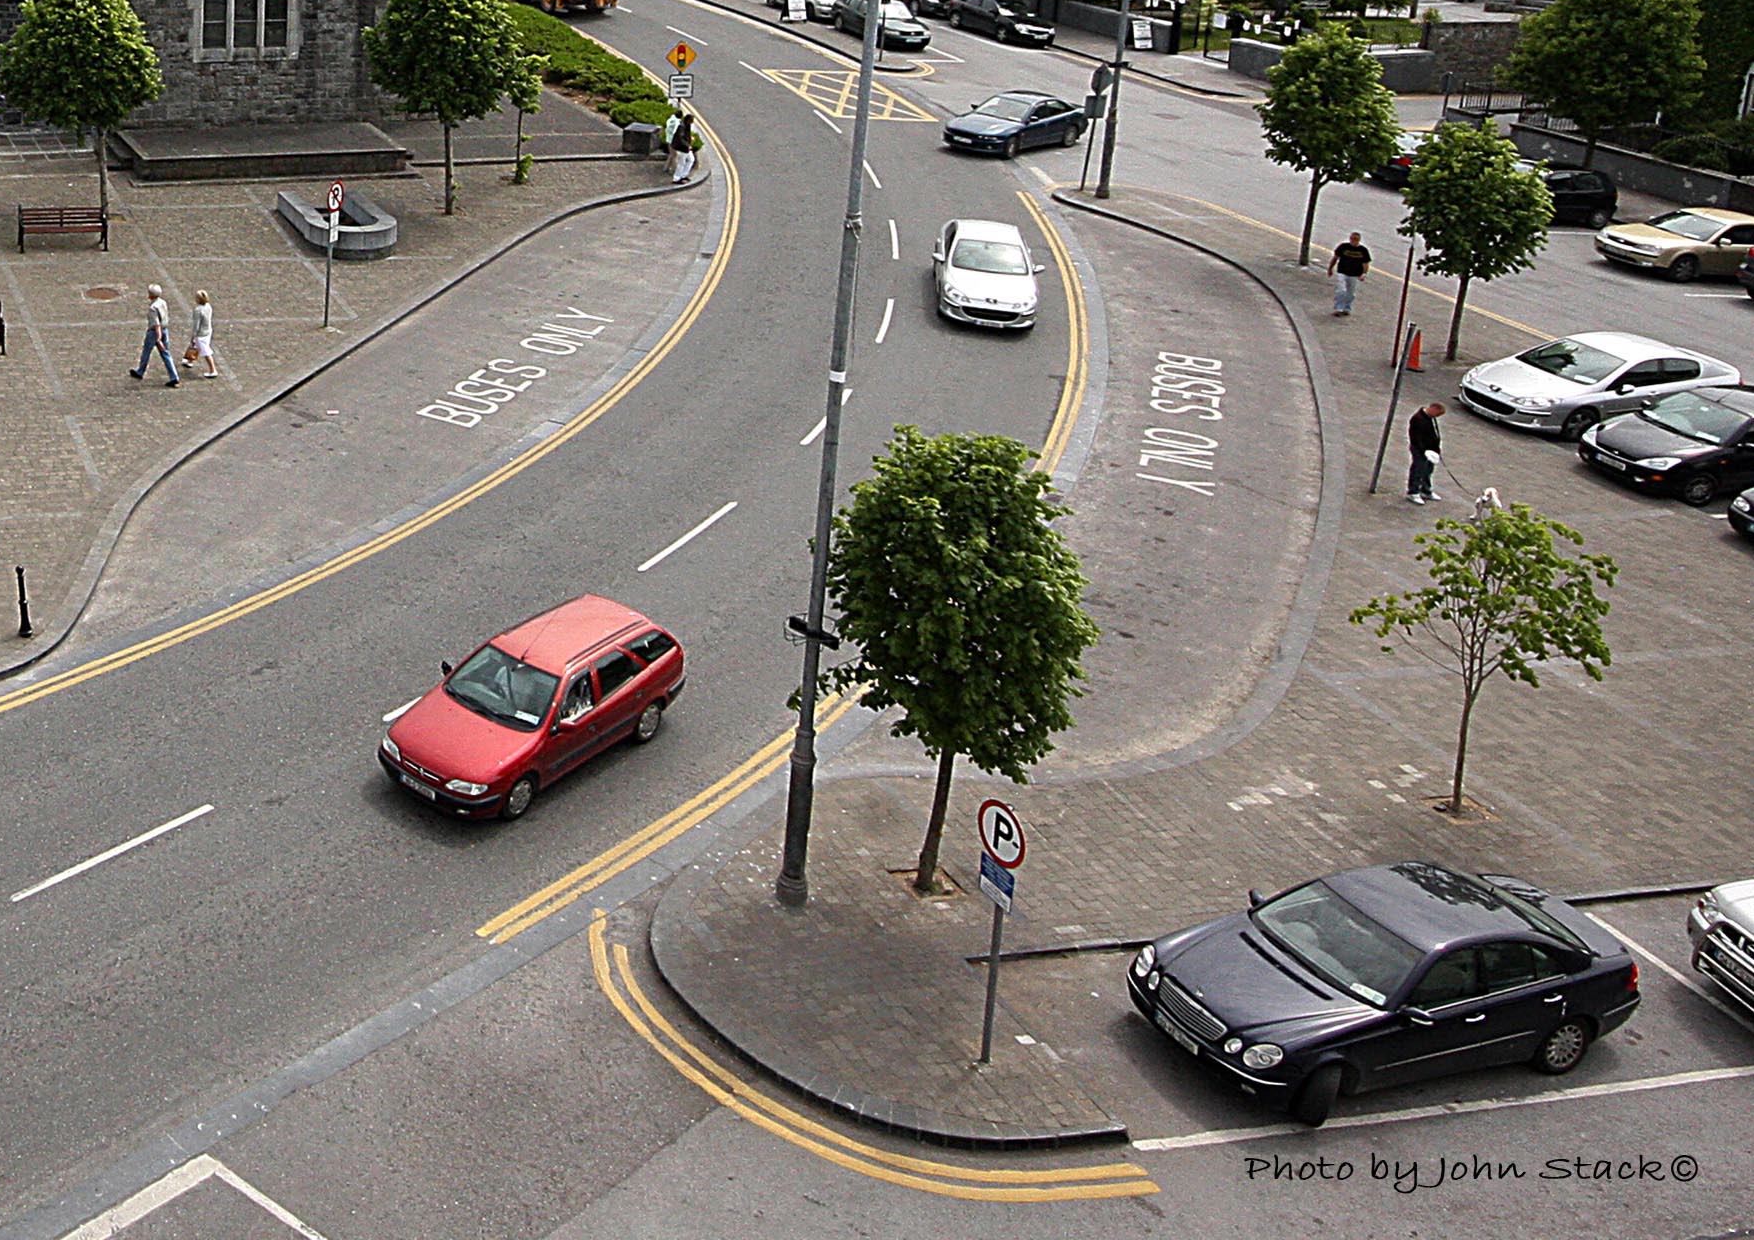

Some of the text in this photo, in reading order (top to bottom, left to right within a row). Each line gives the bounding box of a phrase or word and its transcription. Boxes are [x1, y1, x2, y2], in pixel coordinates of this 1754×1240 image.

[416, 306, 615, 429] BUSES ONLY
[1135, 351, 1226, 497] BUSES ONLY
